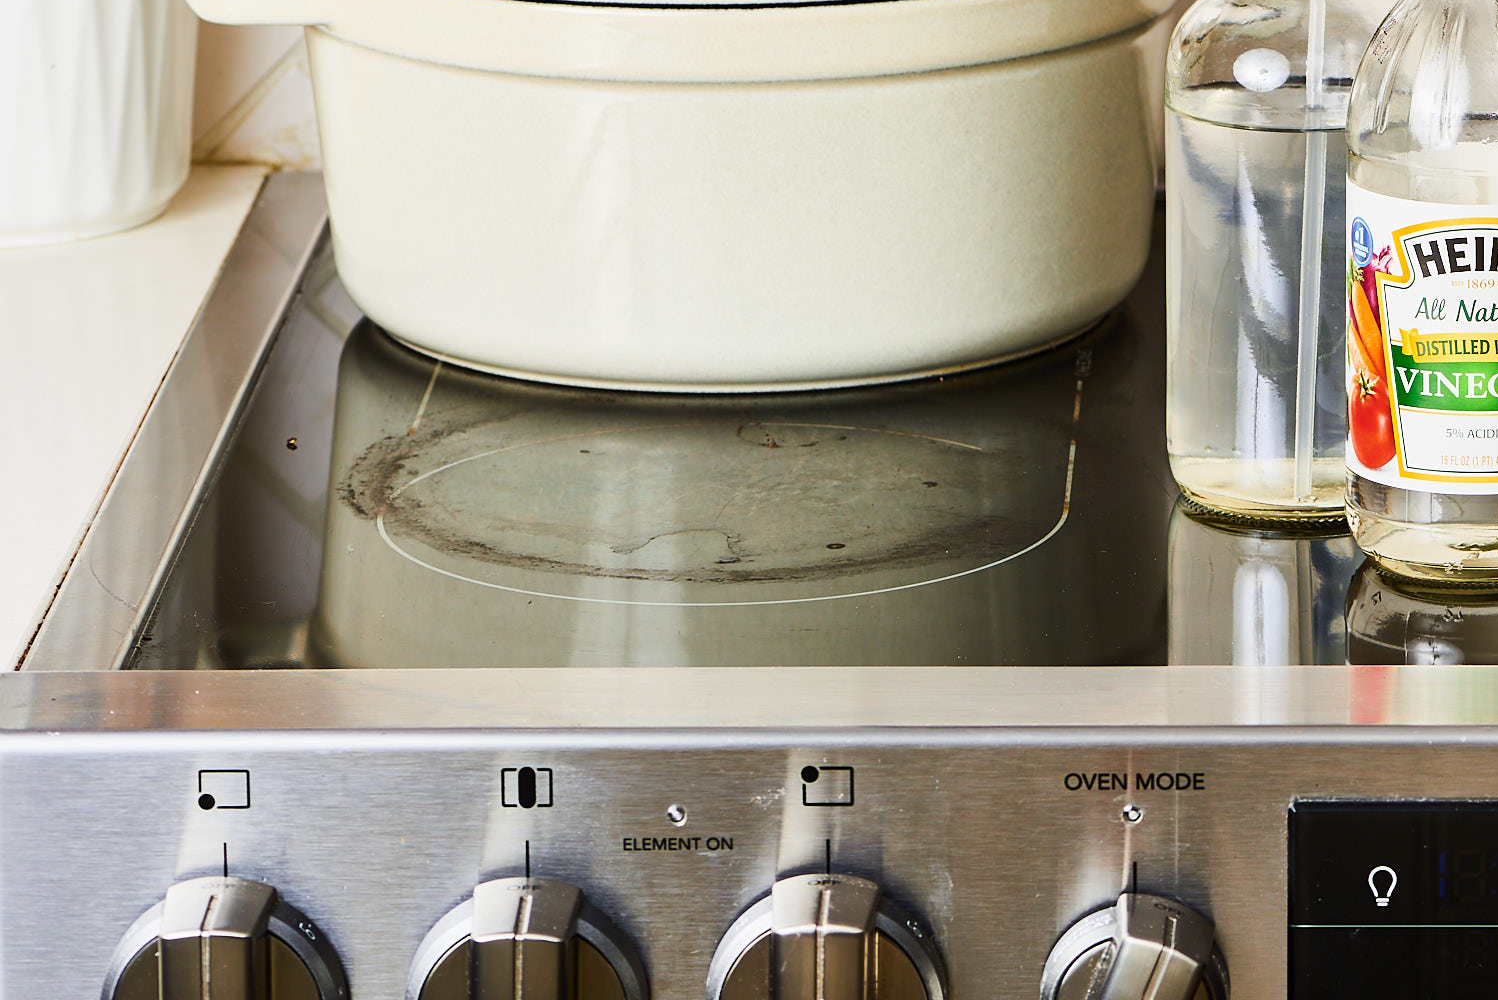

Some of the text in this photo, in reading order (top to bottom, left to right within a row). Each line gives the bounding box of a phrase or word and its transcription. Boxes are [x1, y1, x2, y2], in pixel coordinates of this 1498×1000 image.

[1466, 279, 1495, 290] 1869
[1415, 297, 1447, 321] All
[1416, 340, 1490, 357] DISTILLED
[1446, 428, 1464, 438] 5%
[1450, 455, 1459, 466] FL
[1461, 456, 1470, 467] OZ
[1063, 773, 1206, 791] OVEN MODE
[622, 837, 734, 852] ELEMENT ON
